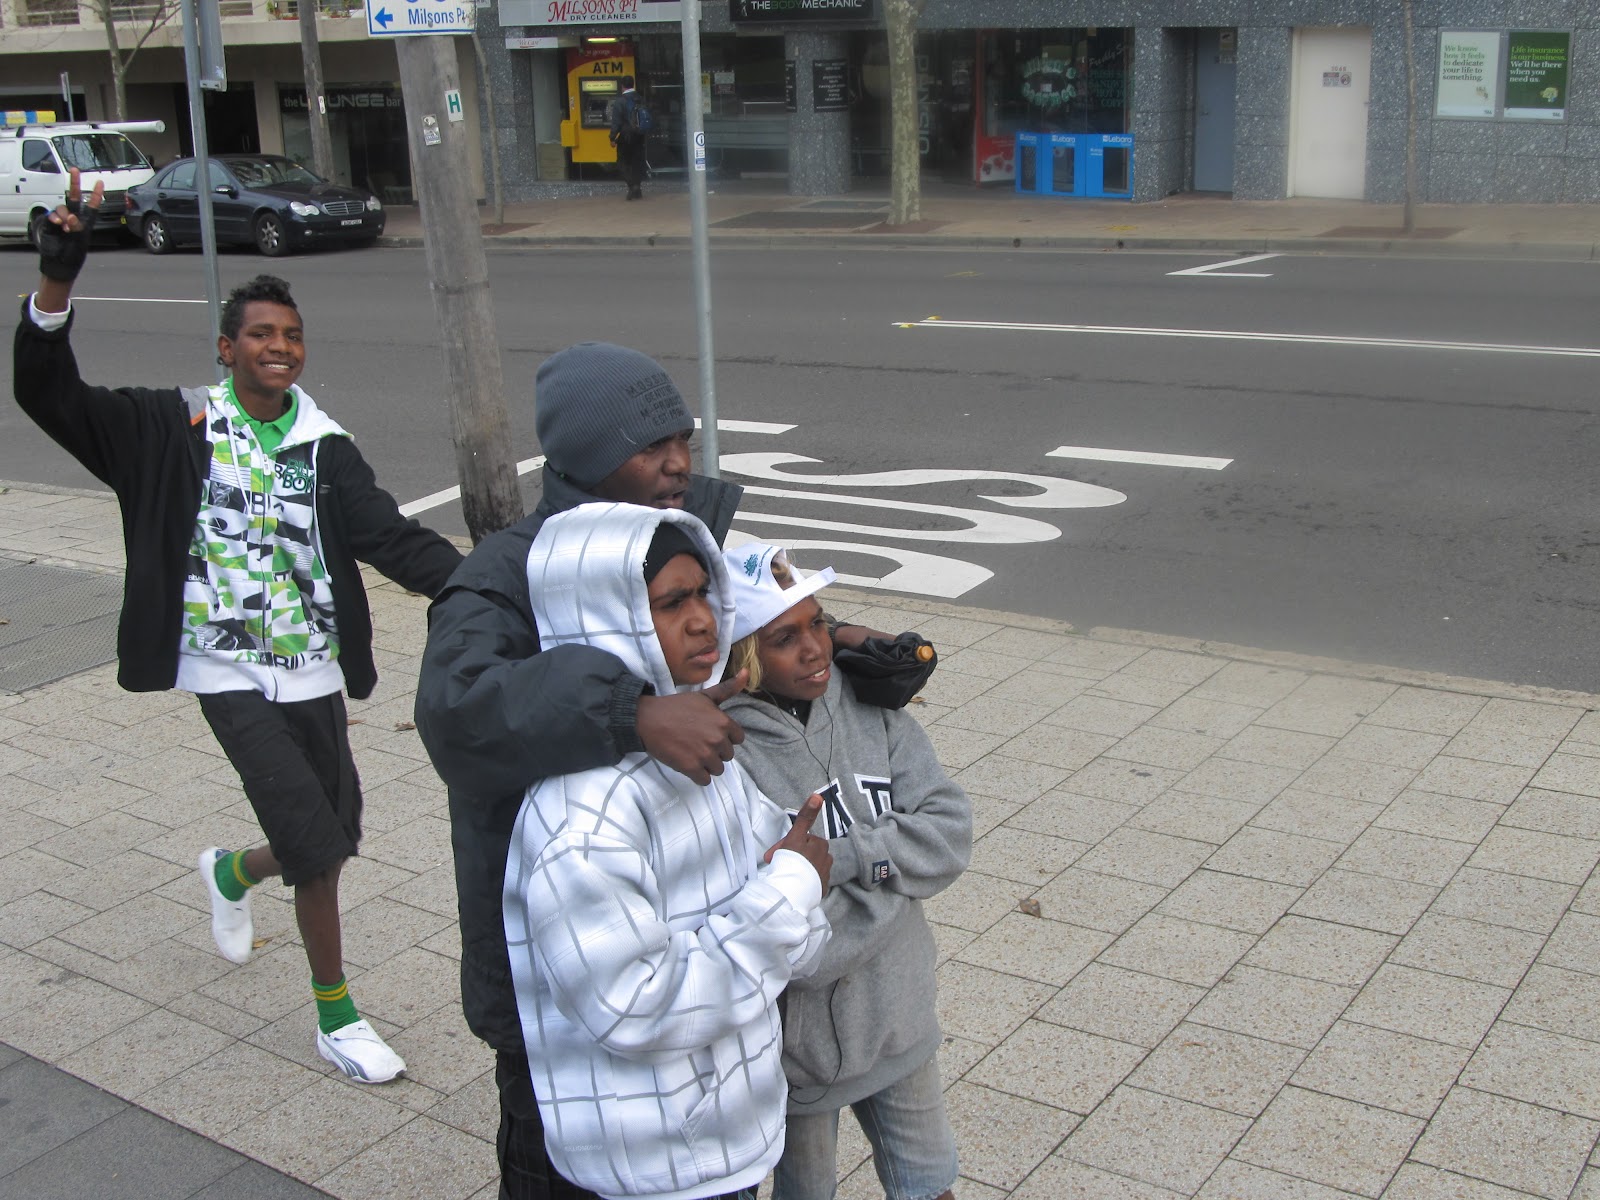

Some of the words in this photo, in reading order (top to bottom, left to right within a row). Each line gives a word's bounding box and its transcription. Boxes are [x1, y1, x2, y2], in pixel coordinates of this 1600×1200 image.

[408, 8, 454, 25] Milsons
[548, 0, 615, 22] MILSONS
[590, 13, 637, 21] CLEANERS
[592, 61, 623, 74] ATM
[1442, 73, 1483, 82] something.
[284, 97, 298, 108] the
[300, 93, 385, 107] LUNGE
[386, 97, 400, 107] bar
[448, 94, 461, 113] H
[1056, 135, 1075, 143] Lebara
[1108, 135, 1132, 143] Lebara
